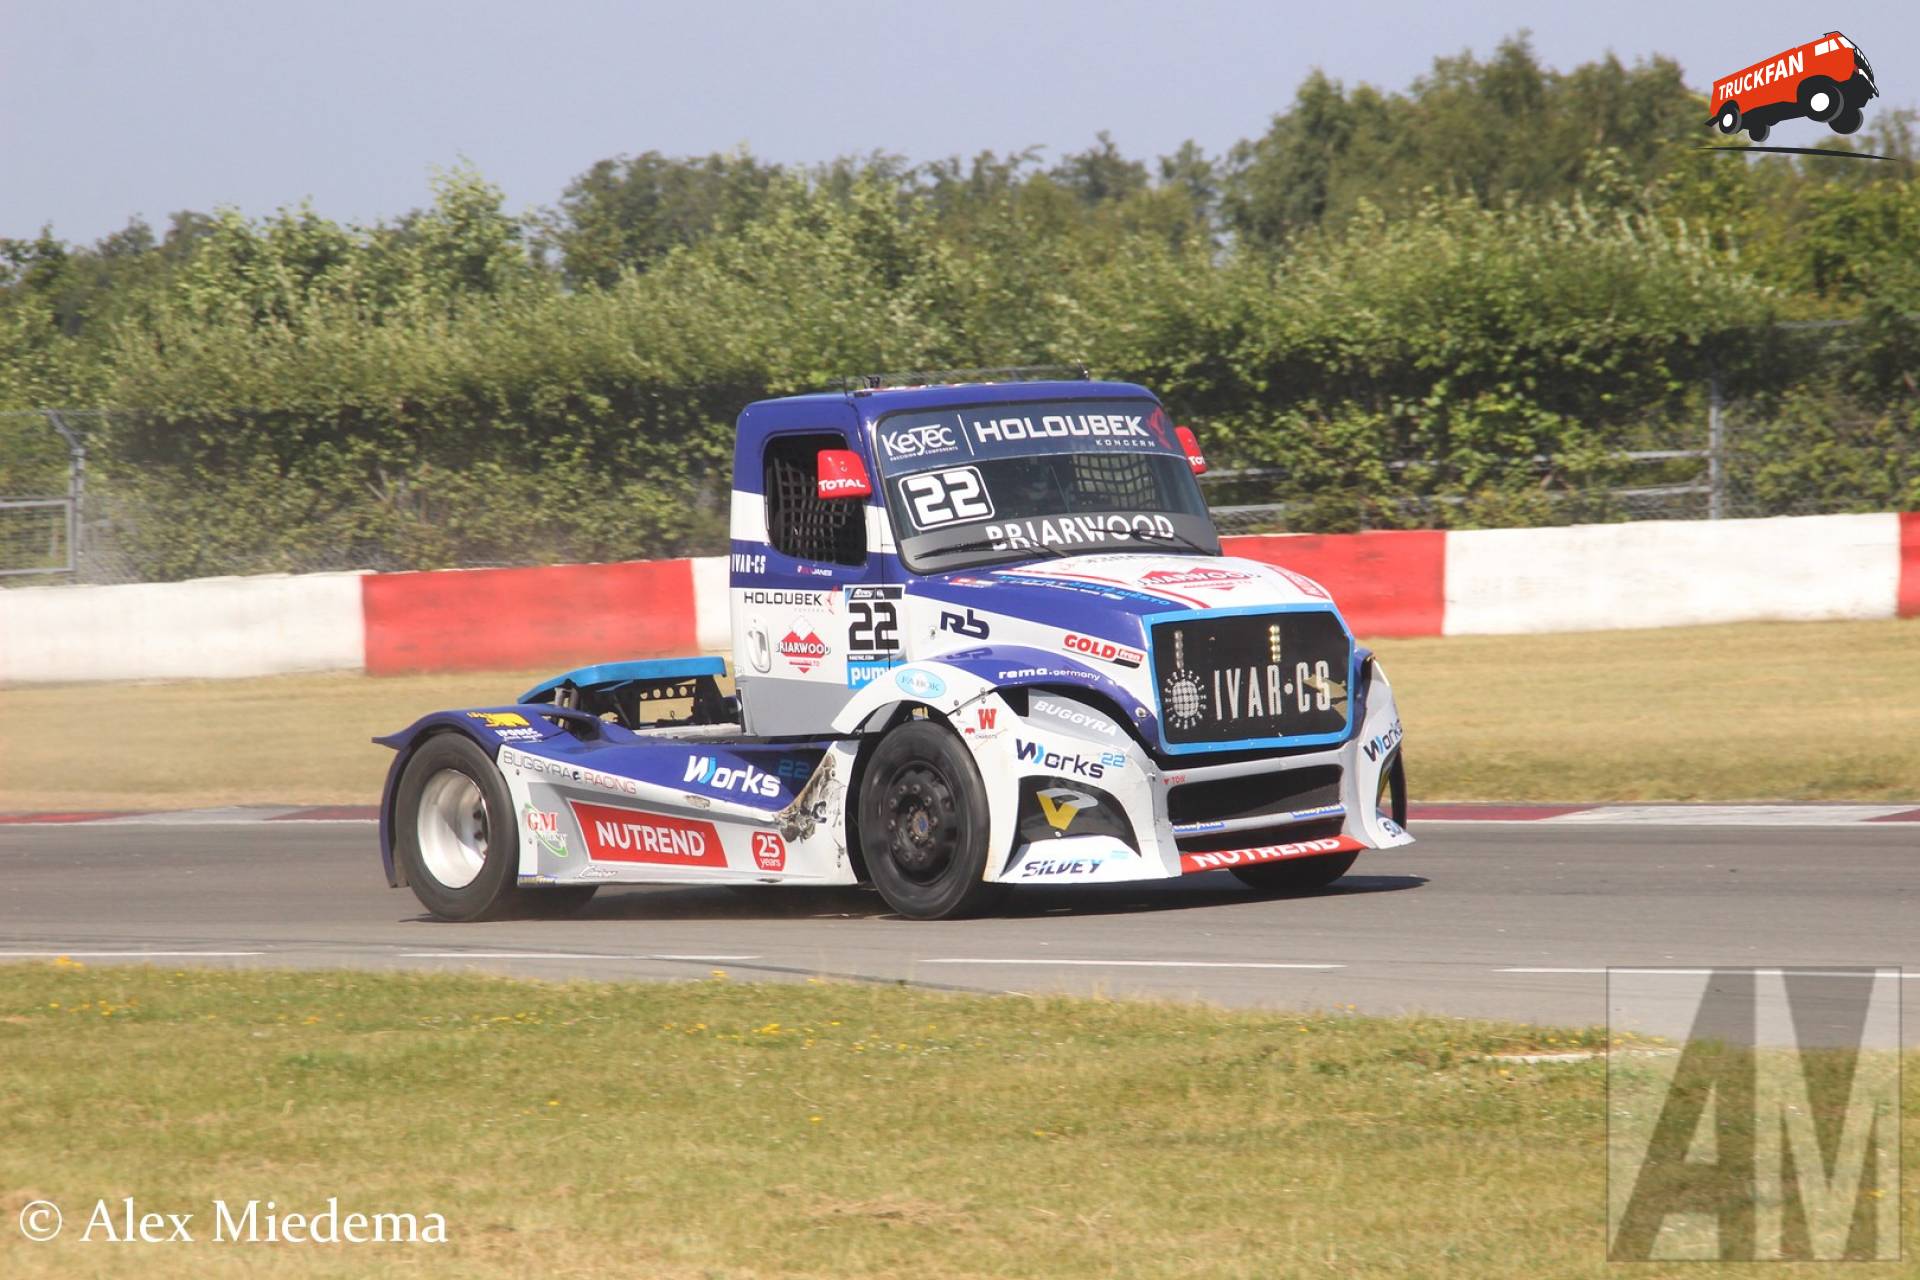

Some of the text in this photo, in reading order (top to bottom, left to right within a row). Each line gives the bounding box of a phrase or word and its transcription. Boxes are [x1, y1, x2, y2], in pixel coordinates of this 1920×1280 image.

[973, 415, 1150, 443] HOLOUBEK
[1095, 438, 1156, 448] KONCERN
[818, 479, 866, 492] TOTAL
[907, 472, 988, 525] 22
[985, 514, 1175, 551] BRIARWOOD
[744, 591, 823, 607] HOLOUBEK
[848, 602, 900, 651] 22
[850, 666, 890, 686] pum
[977, 708, 998, 730] W
[1033, 700, 1118, 737] BUGGYRA
[503, 750, 637, 795] BUGGYRA RACING
[1016, 738, 1127, 779] Works 22
[682, 755, 810, 798] Works 22
[527, 811, 559, 833] GM
[595, 820, 705, 858] NUTREND
[756, 833, 781, 858] 25
[1190, 838, 1341, 868] NUTREND
[759, 857, 782, 869] years
